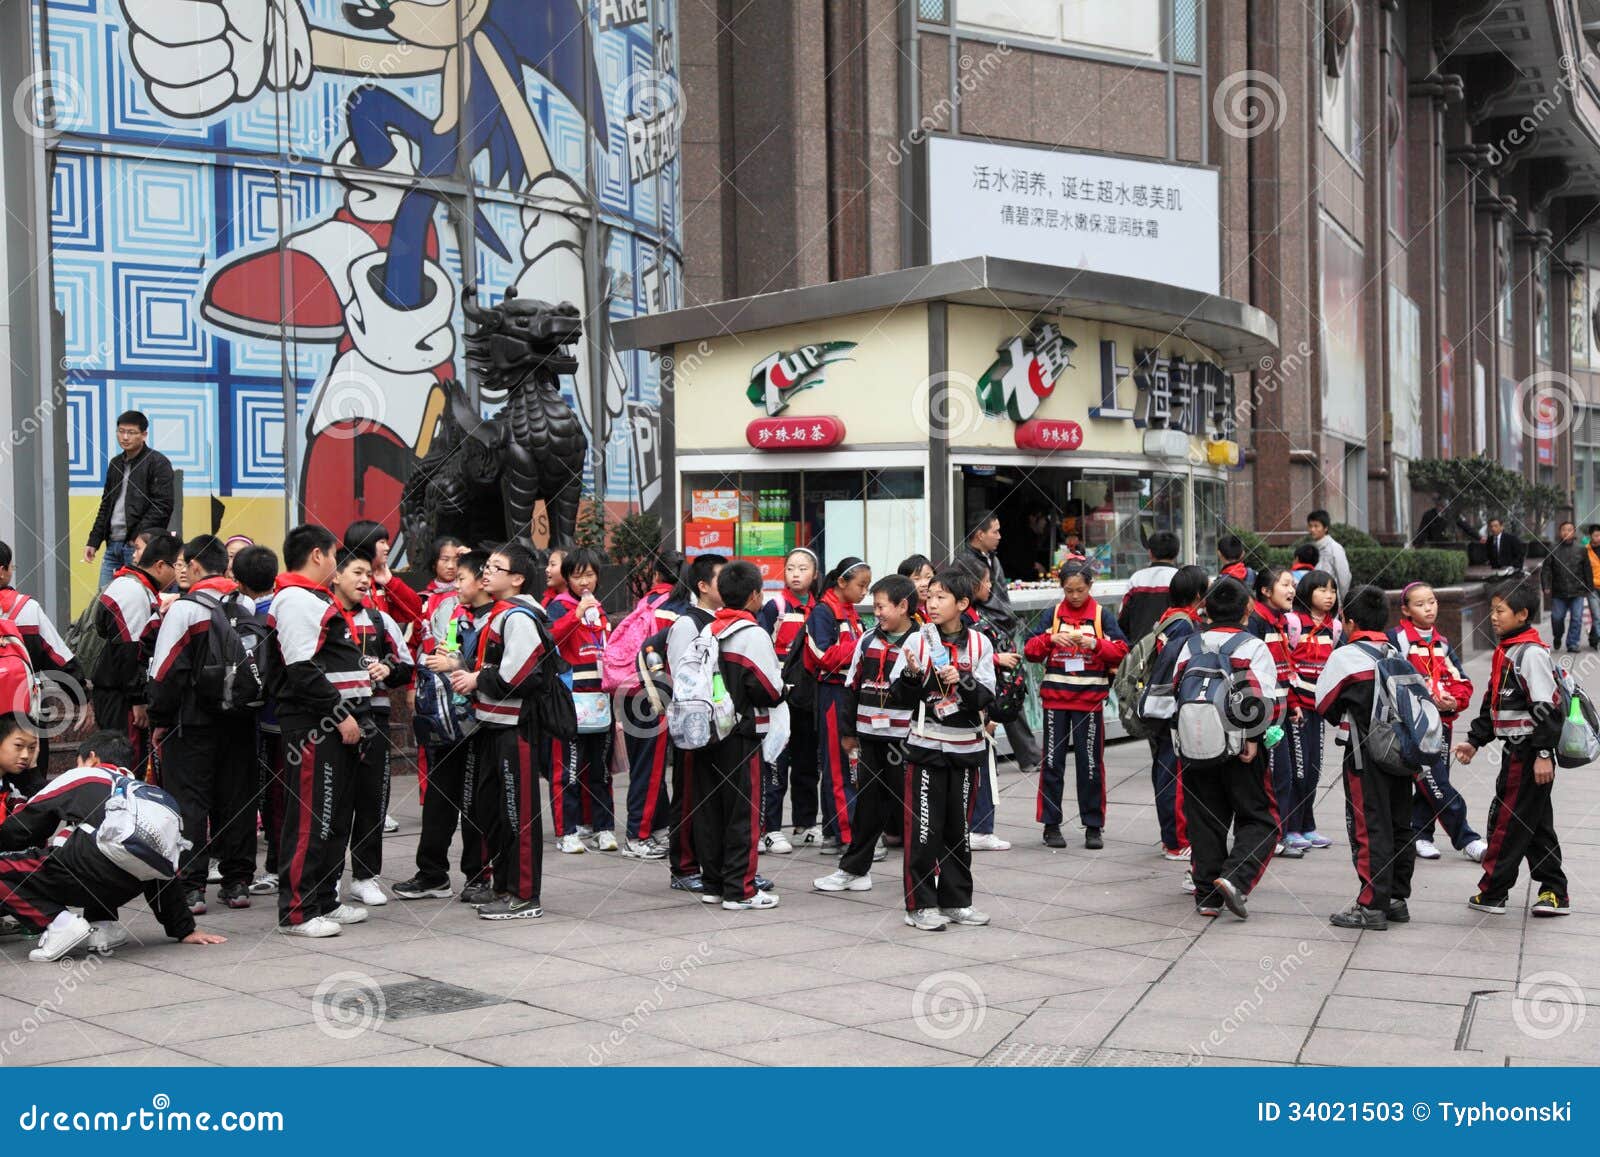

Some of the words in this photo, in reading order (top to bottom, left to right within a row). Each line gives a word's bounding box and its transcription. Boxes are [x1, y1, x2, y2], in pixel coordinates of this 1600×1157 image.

[758, 424, 826, 443] 珍珠奶茶
[1041, 426, 1080, 444] 珍珠奶茶
[321, 762, 334, 841] JIANSHENG
[919, 769, 931, 846] JIANSHENG
